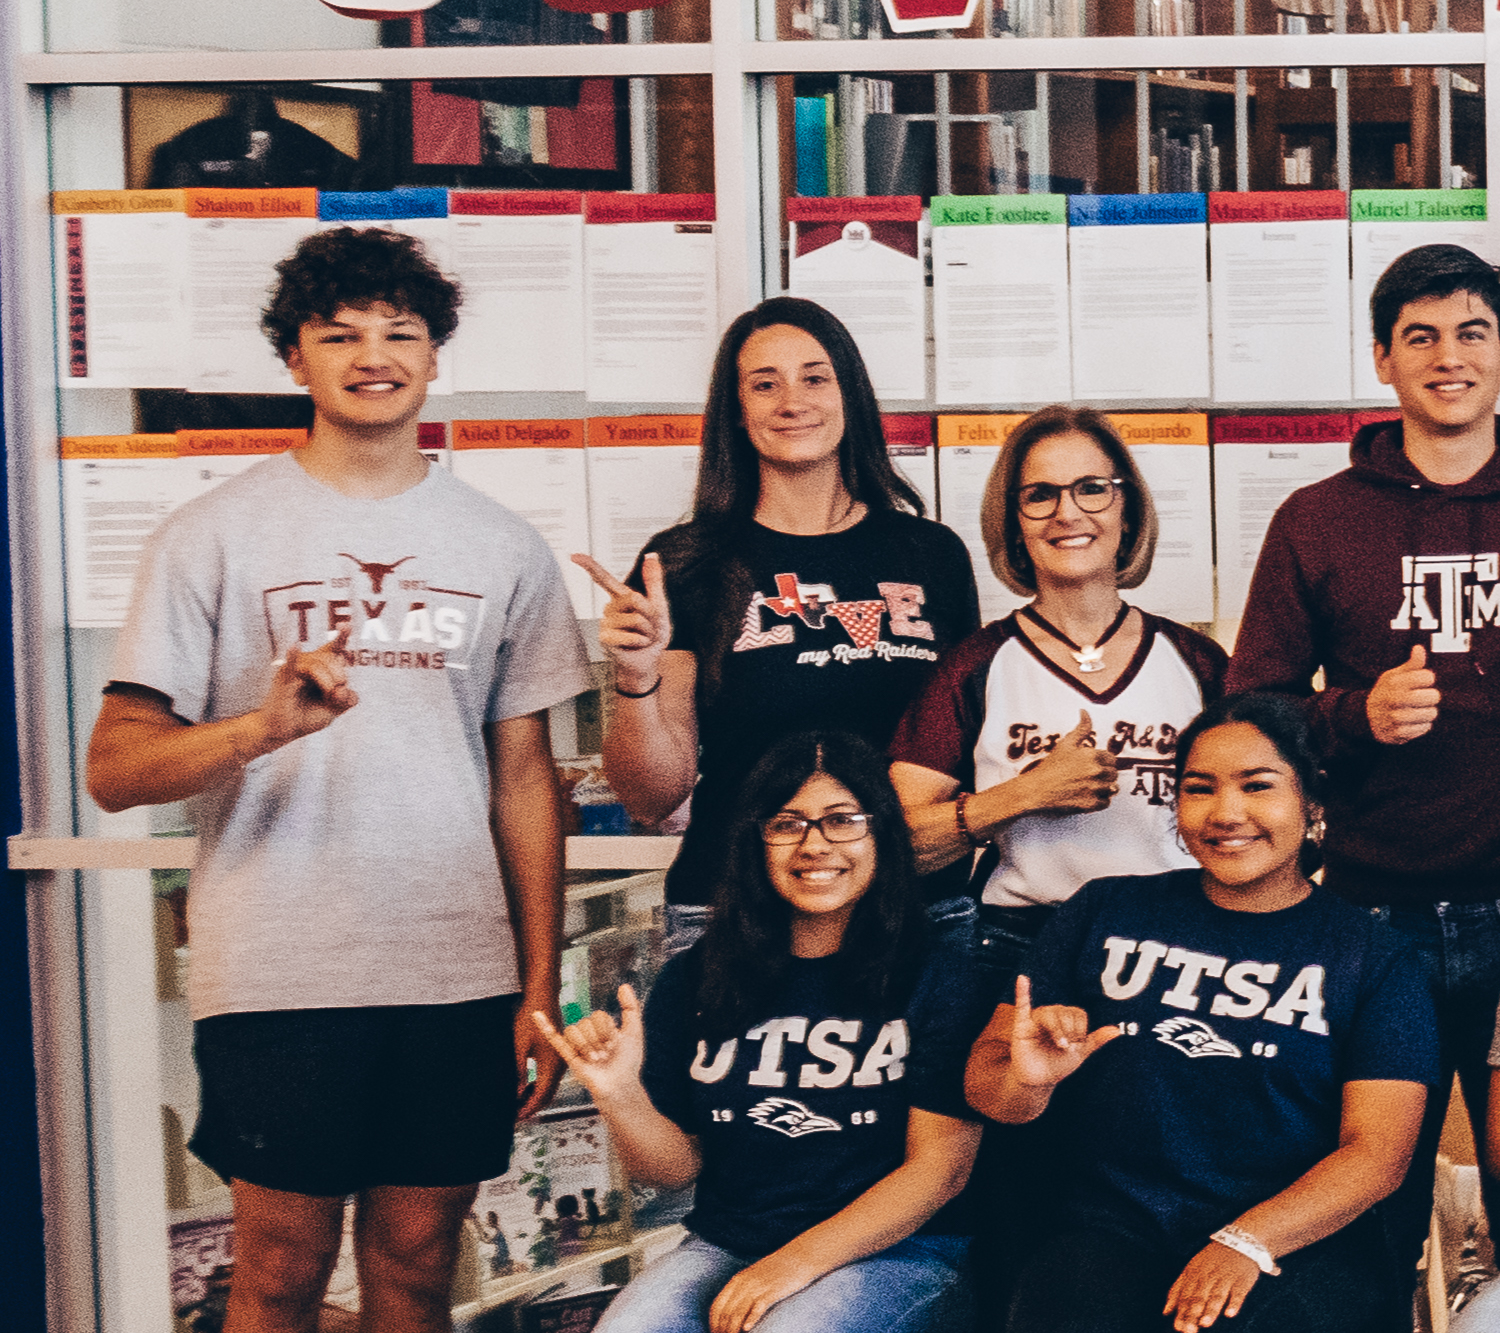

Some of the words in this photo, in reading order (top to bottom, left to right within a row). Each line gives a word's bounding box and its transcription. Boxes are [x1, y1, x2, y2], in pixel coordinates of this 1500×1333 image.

[195, 198, 255, 215] Shalom
[943, 206, 979, 223] Kate
[984, 206, 1050, 221] Fooshee
[1356, 202, 1411, 219] Mariel
[1416, 201, 1486, 217] Talavera
[457, 425, 500, 441] Ailed
[504, 424, 571, 445] Delgado
[604, 424, 658, 440] Yanira
[662, 422, 699, 439] Ruiz
[188, 436, 239, 451] Carlos
[288, 599, 468, 650] TEXAS
[796, 650, 832, 667] my
[832, 643, 874, 666] Red
[875, 641, 939, 663] Raiders
[1100, 935, 1331, 1037] UTSA
[1117, 1021, 1140, 1036] 19
[689, 1015, 912, 1089] UTSA
[711, 1108, 735, 1123] 19
[850, 1109, 879, 1125] 69
